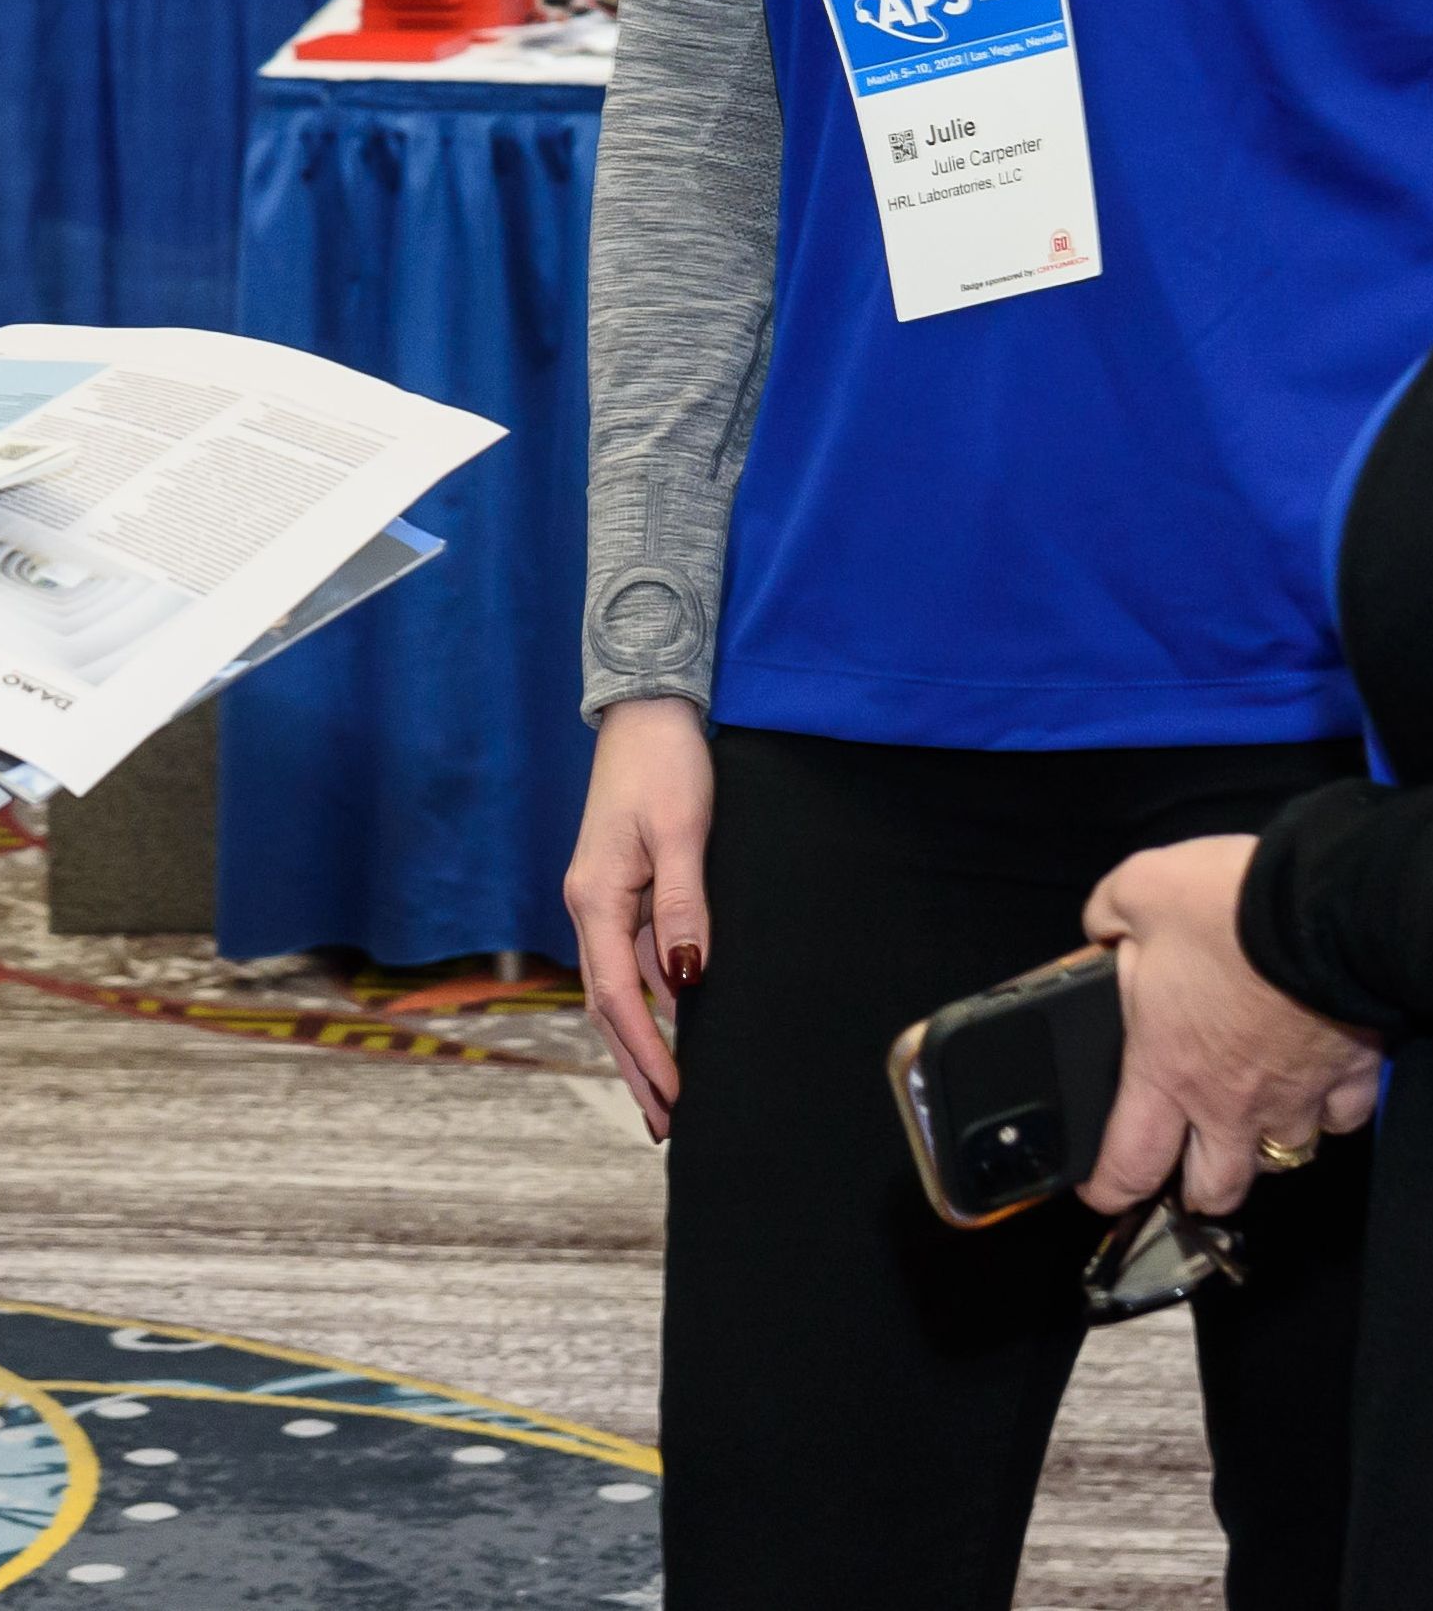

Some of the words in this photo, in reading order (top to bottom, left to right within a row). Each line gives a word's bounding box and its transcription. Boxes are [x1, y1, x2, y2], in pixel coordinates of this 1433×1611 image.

[866, 69, 899, 88] March
[934, 55, 963, 70] 2023
[969, 48, 990, 63] Las
[925, 118, 976, 146] Julie
[931, 155, 966, 176] Julie
[969, 138, 1043, 167] Carpenter
[887, 194, 916, 211] HRL
[998, 168, 1023, 185] LLC
